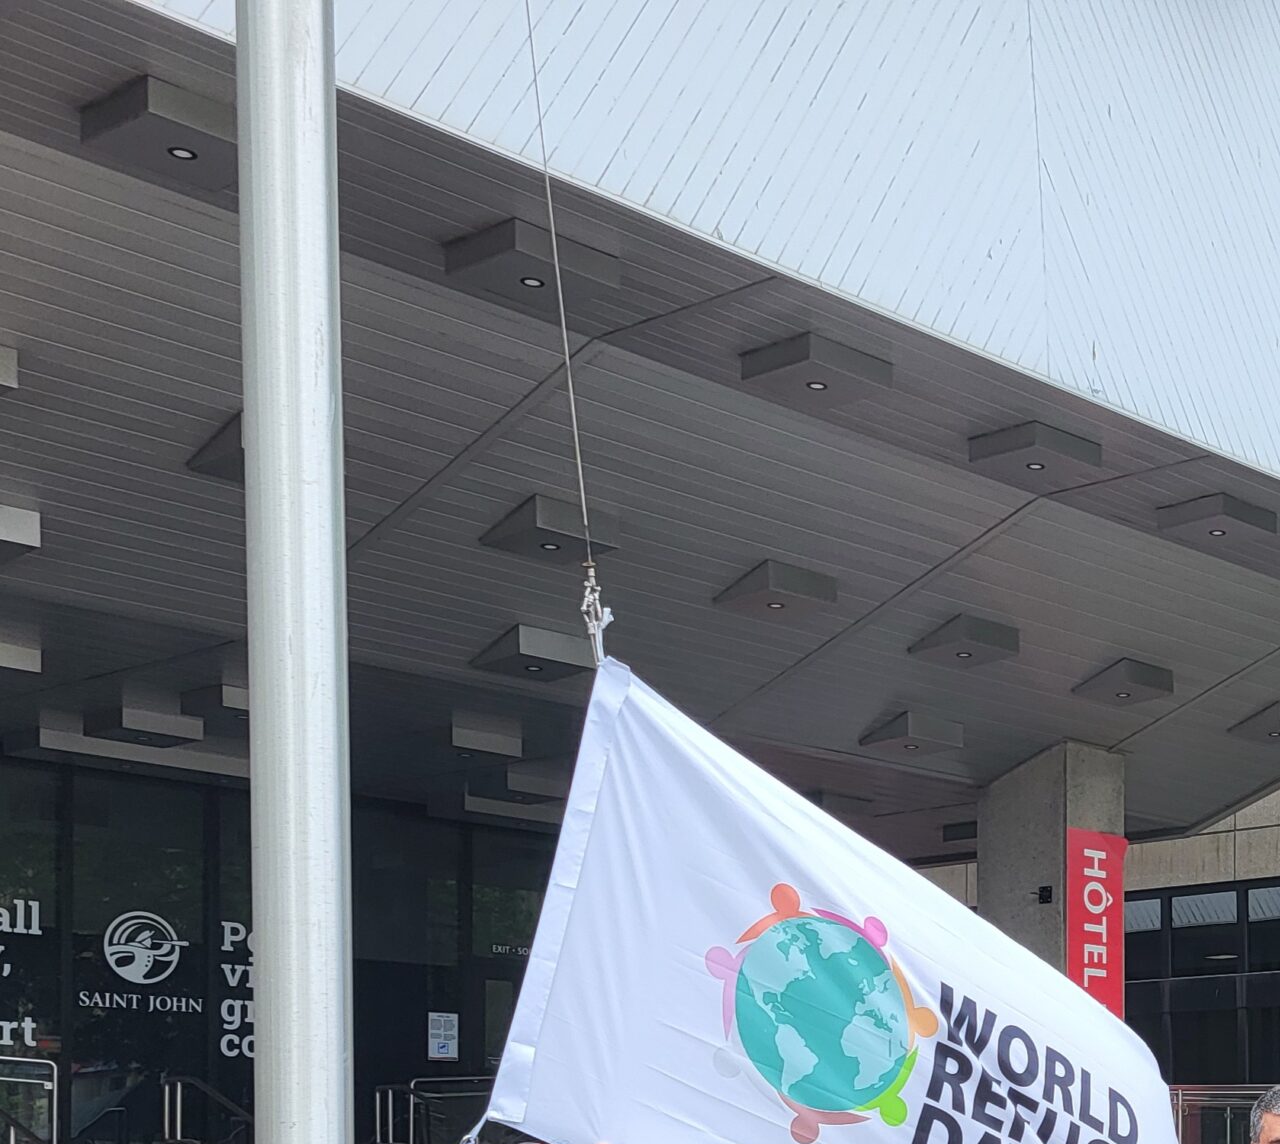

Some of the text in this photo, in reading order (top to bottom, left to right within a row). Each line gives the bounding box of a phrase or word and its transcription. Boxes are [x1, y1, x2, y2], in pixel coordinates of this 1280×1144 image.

[1084, 848, 1113, 987] HÔTEL
[492, 944, 510, 954] EXIT
[79, 991, 203, 1013] SAINT JOHN
